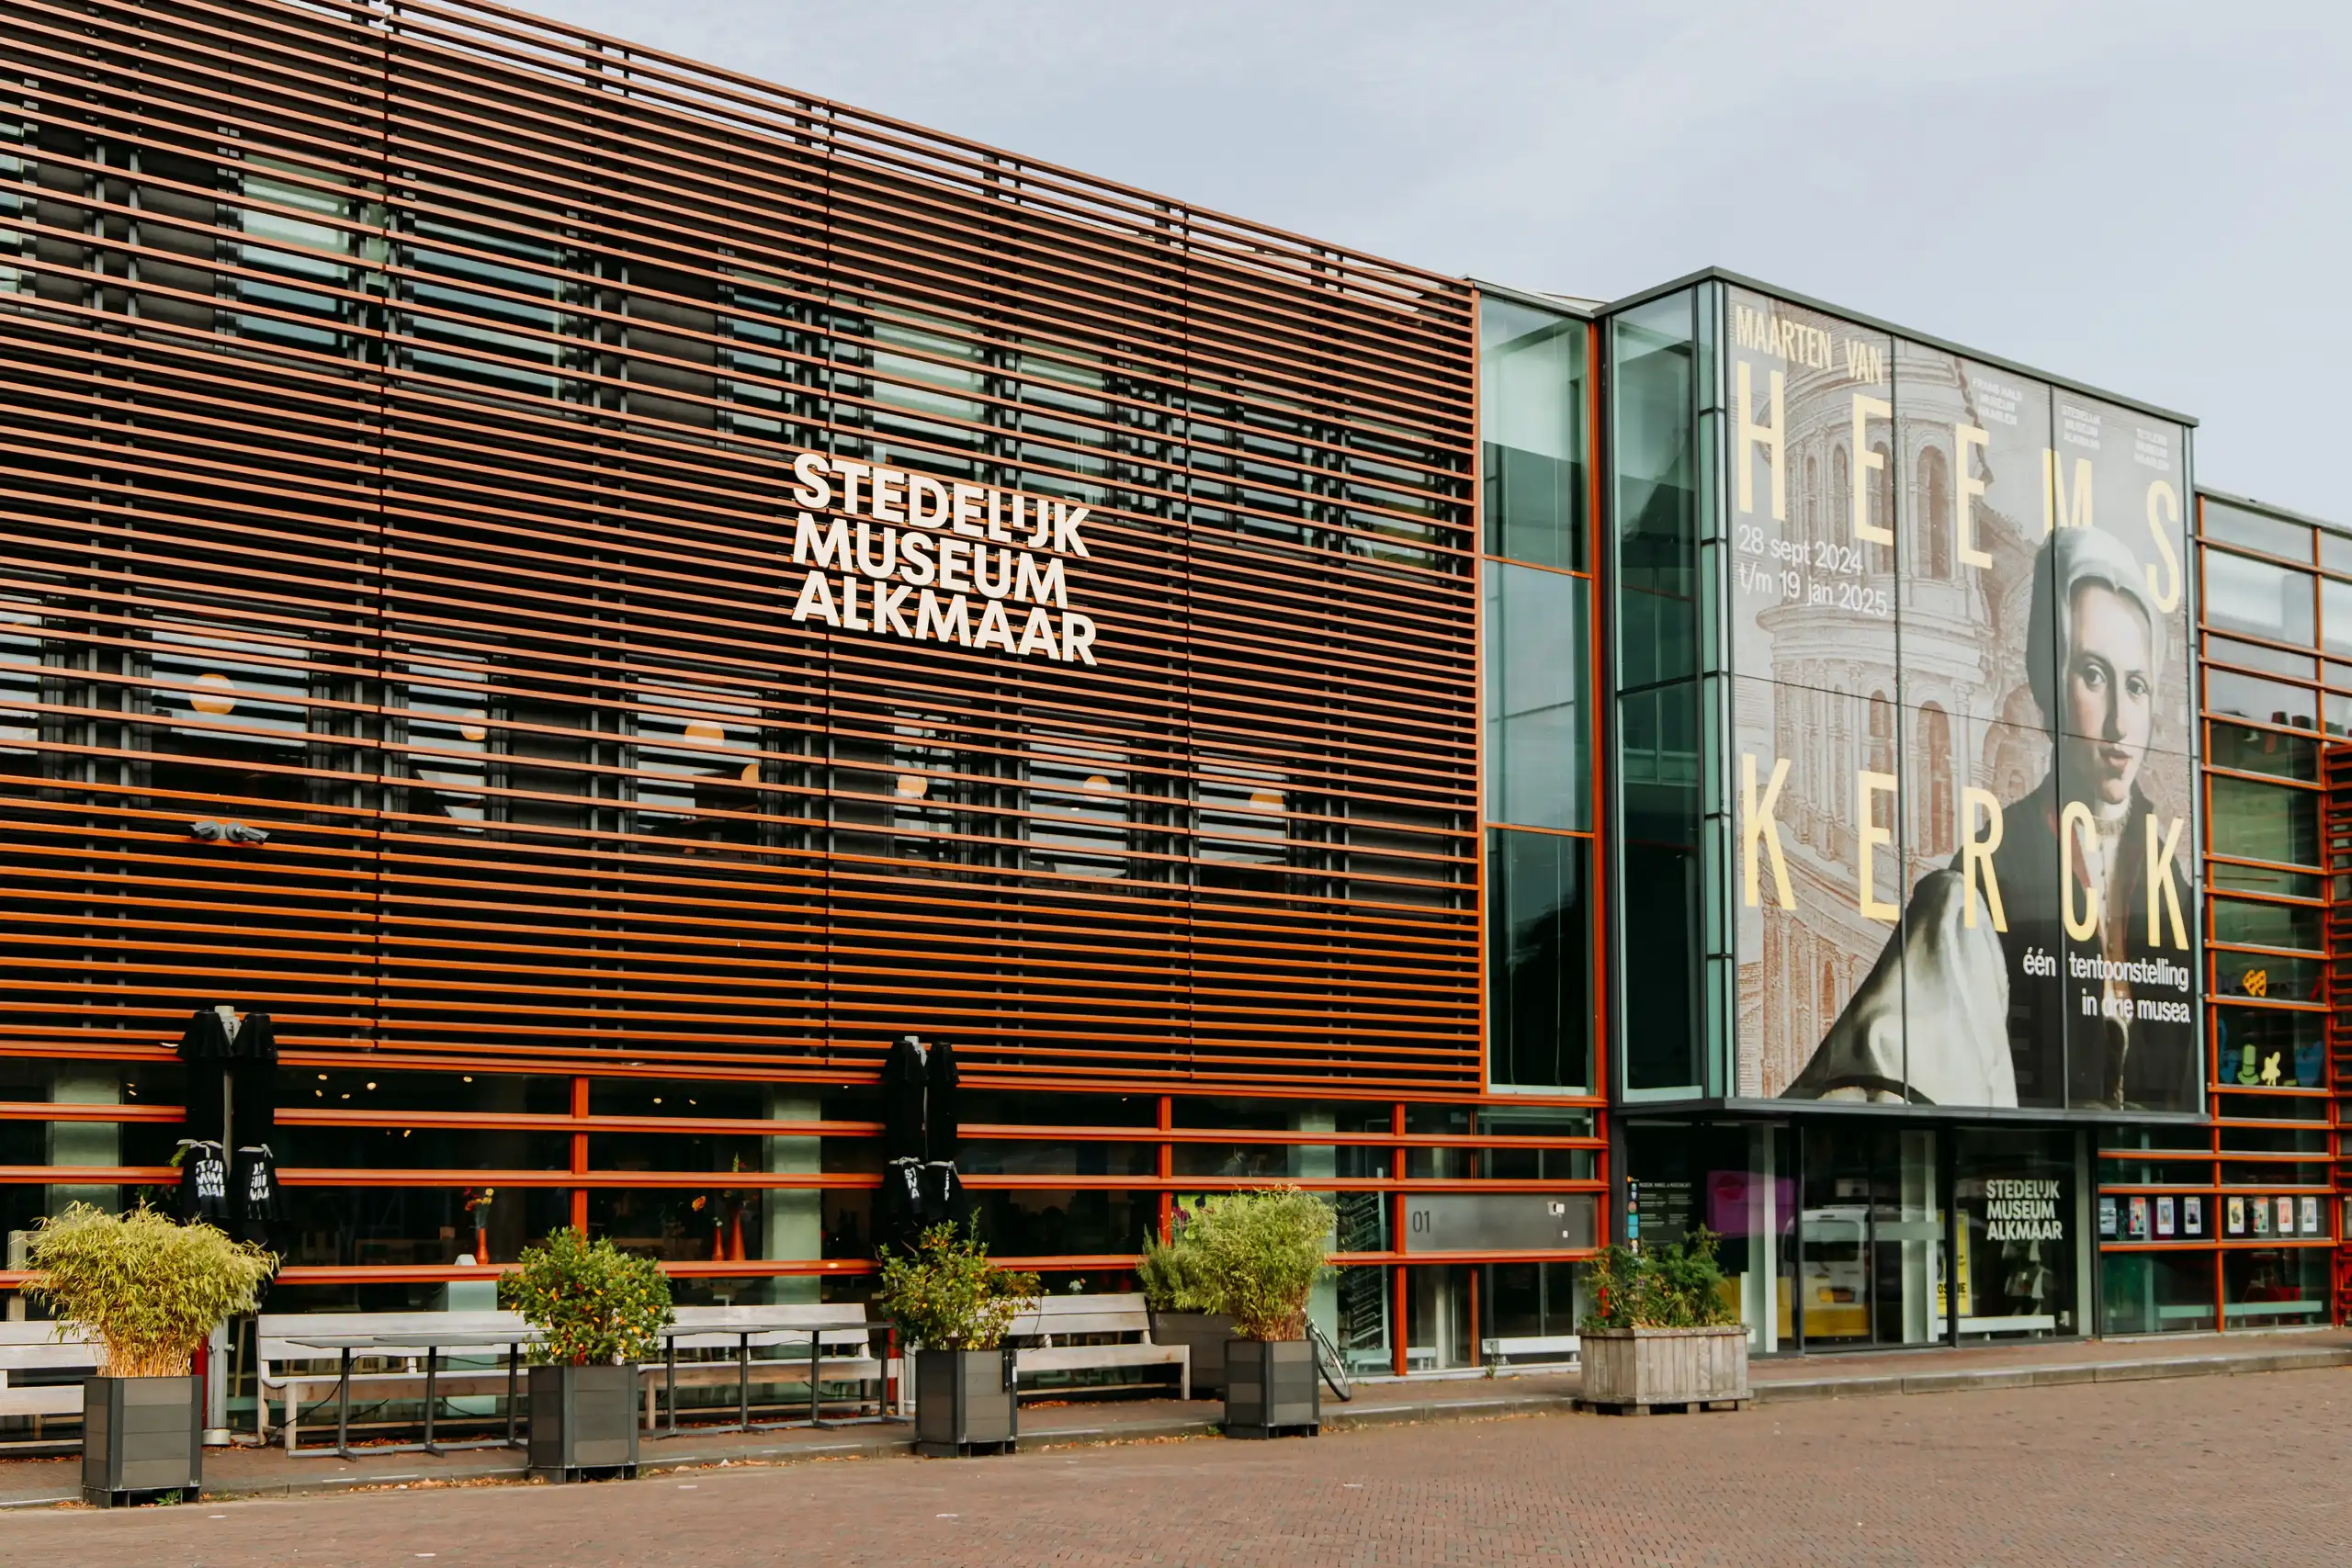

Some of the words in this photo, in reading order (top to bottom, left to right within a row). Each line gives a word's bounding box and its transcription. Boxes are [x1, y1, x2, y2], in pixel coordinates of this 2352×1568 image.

[1736, 305, 1832, 372] MAARTEN
[1845, 338, 1883, 386] VAN
[793, 453, 1091, 558] STEDELIJK
[792, 512, 1069, 609] MUSEUM
[1739, 525, 1764, 554] 28
[1770, 538, 1811, 567] sept
[1815, 541, 1863, 576] 2024
[1738, 562, 1772, 595] t/m
[1780, 570, 1801, 598] 19
[1806, 576, 1834, 606] jan
[1838, 582, 1887, 617] 2025
[791, 570, 1098, 666] ALKMAAR
[1742, 753, 2189, 951] KERCK
[2022, 946, 2056, 976] één
[2068, 951, 2189, 992] tentoonstelling
[2081, 987, 2098, 1016] in
[2101, 989, 2133, 1020] drie
[2136, 998, 2190, 1023] musea
[1985, 1179, 2061, 1200] STEDELIJK
[1986, 1200, 2055, 1220] MUSEUM
[1412, 1210, 1430, 1234] 01
[1986, 1220, 2063, 1241] ALKMAAR
